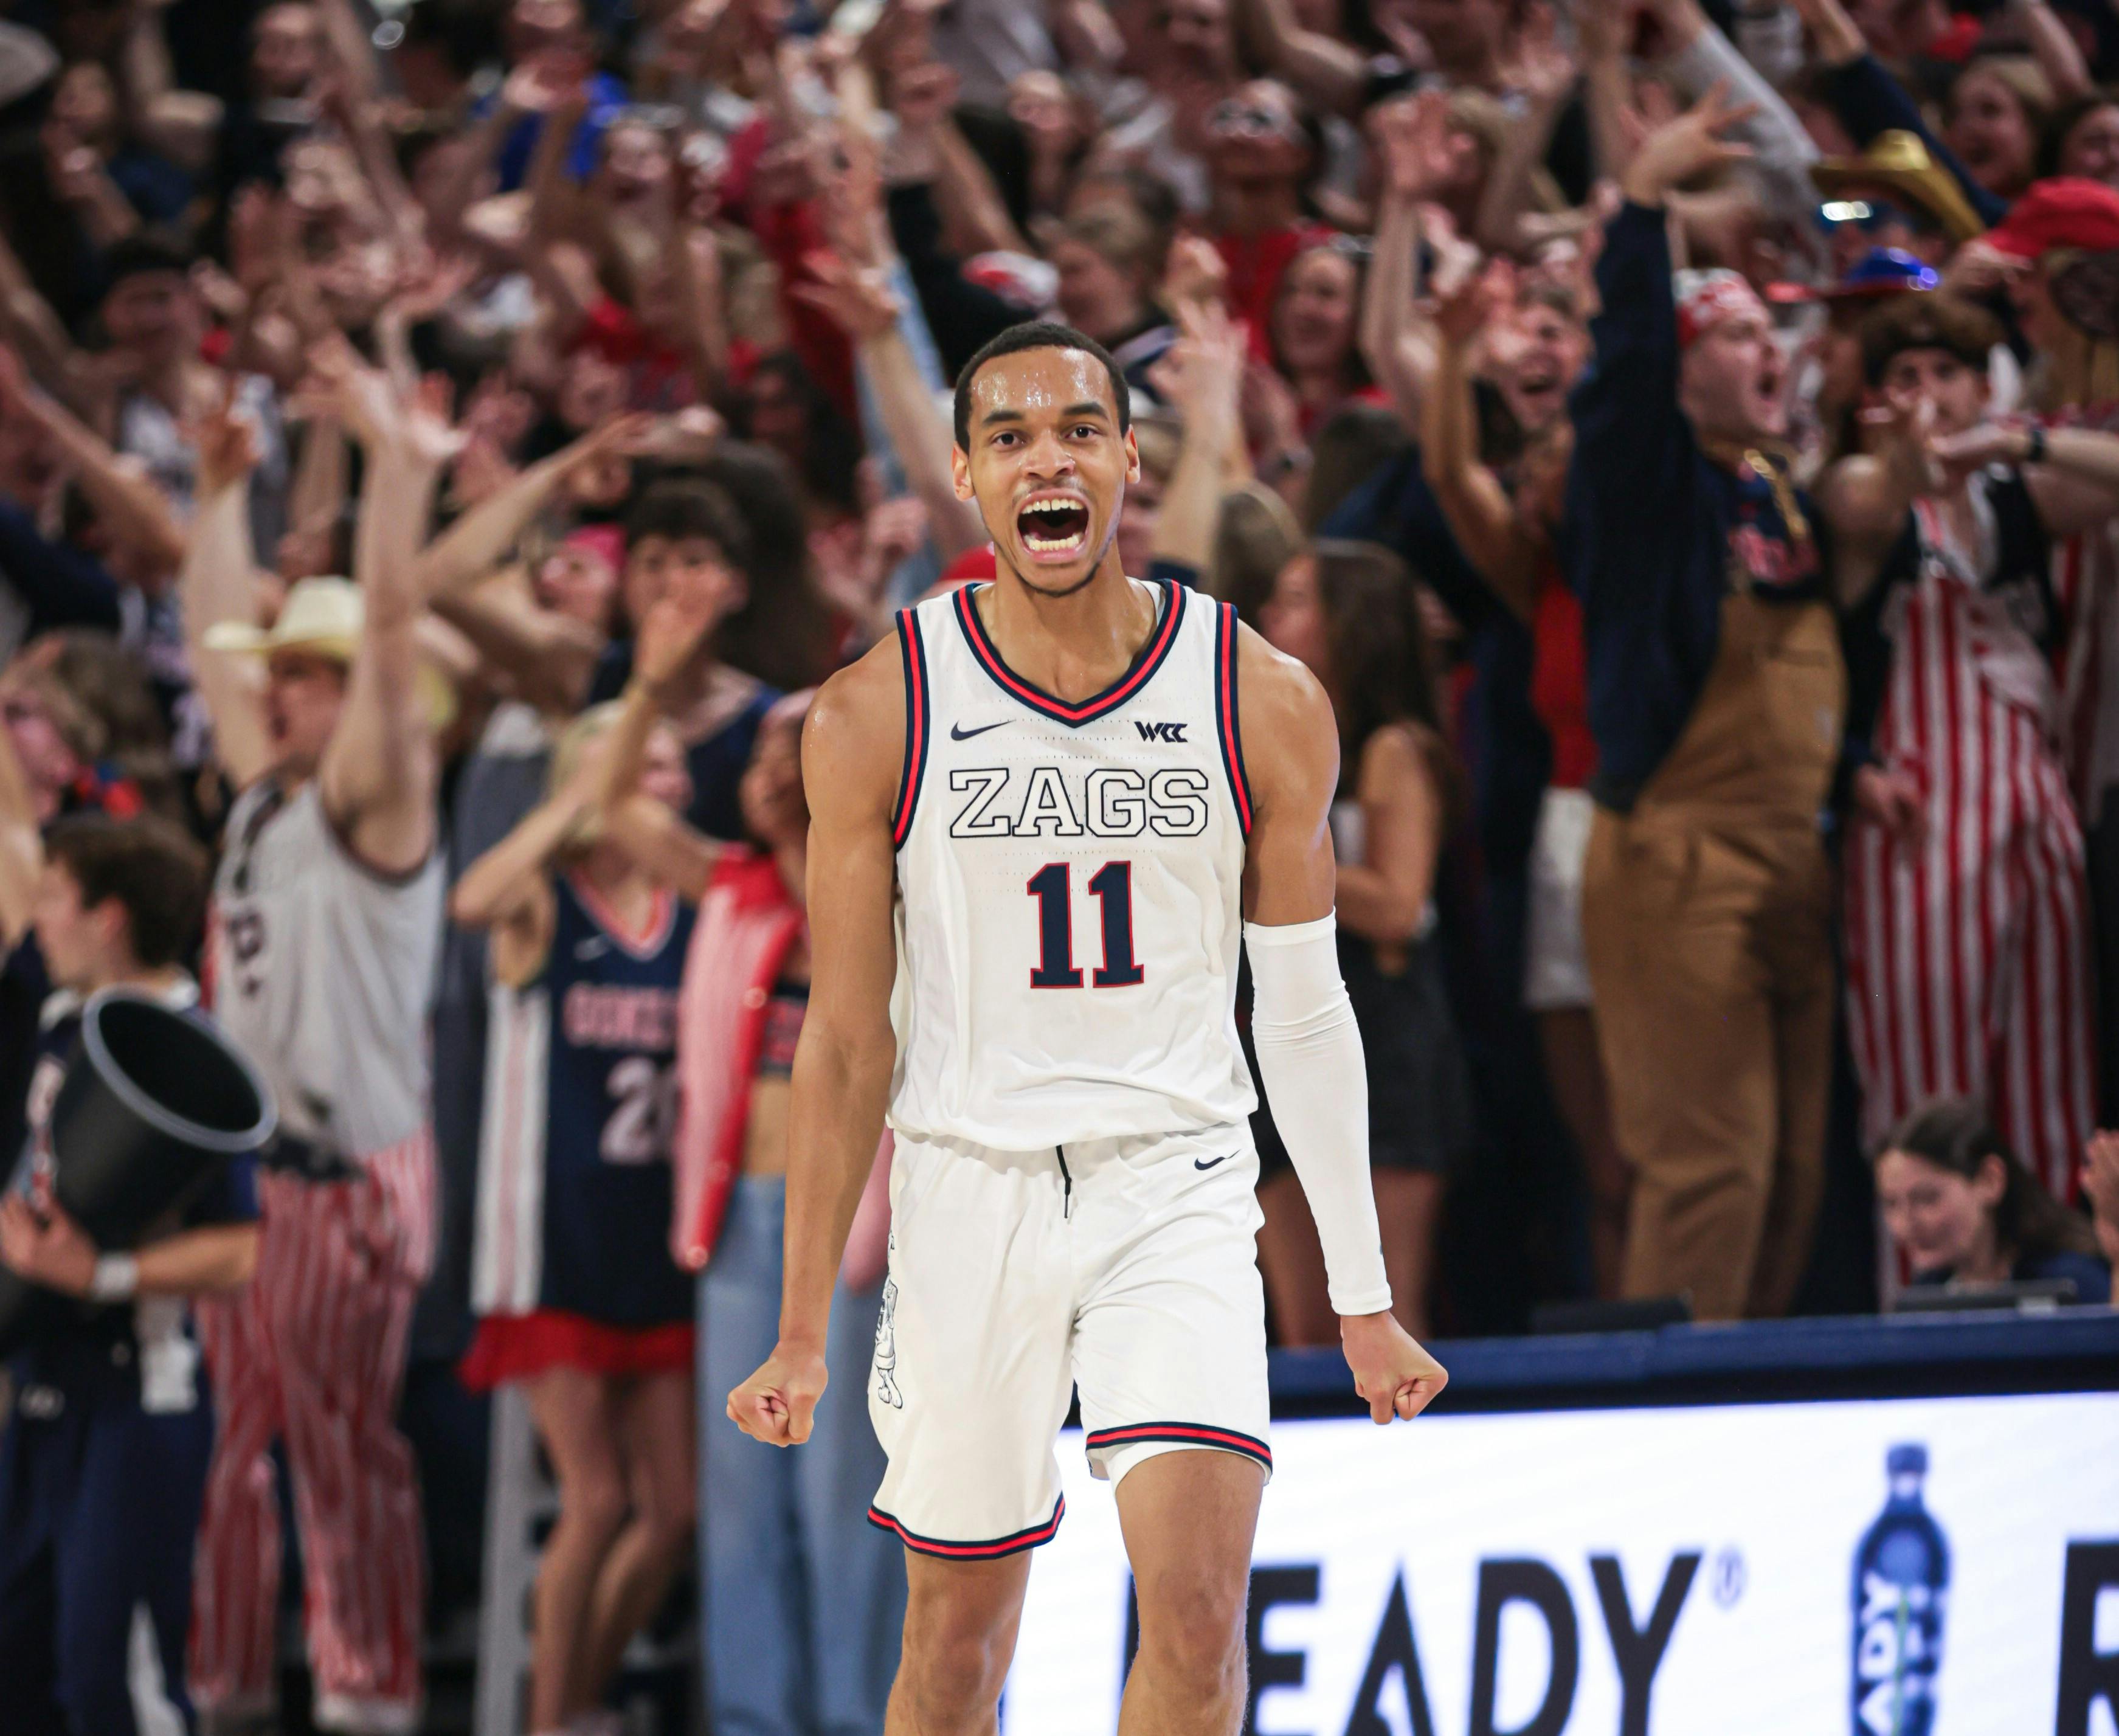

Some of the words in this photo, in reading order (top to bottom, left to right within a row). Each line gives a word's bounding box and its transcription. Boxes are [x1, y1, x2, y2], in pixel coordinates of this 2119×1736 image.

[1133, 721, 1189, 743] WCC
[950, 767, 1208, 839] ZAGS
[1026, 860, 1144, 989] 11
[1122, 1551, 1702, 1736] EADY
